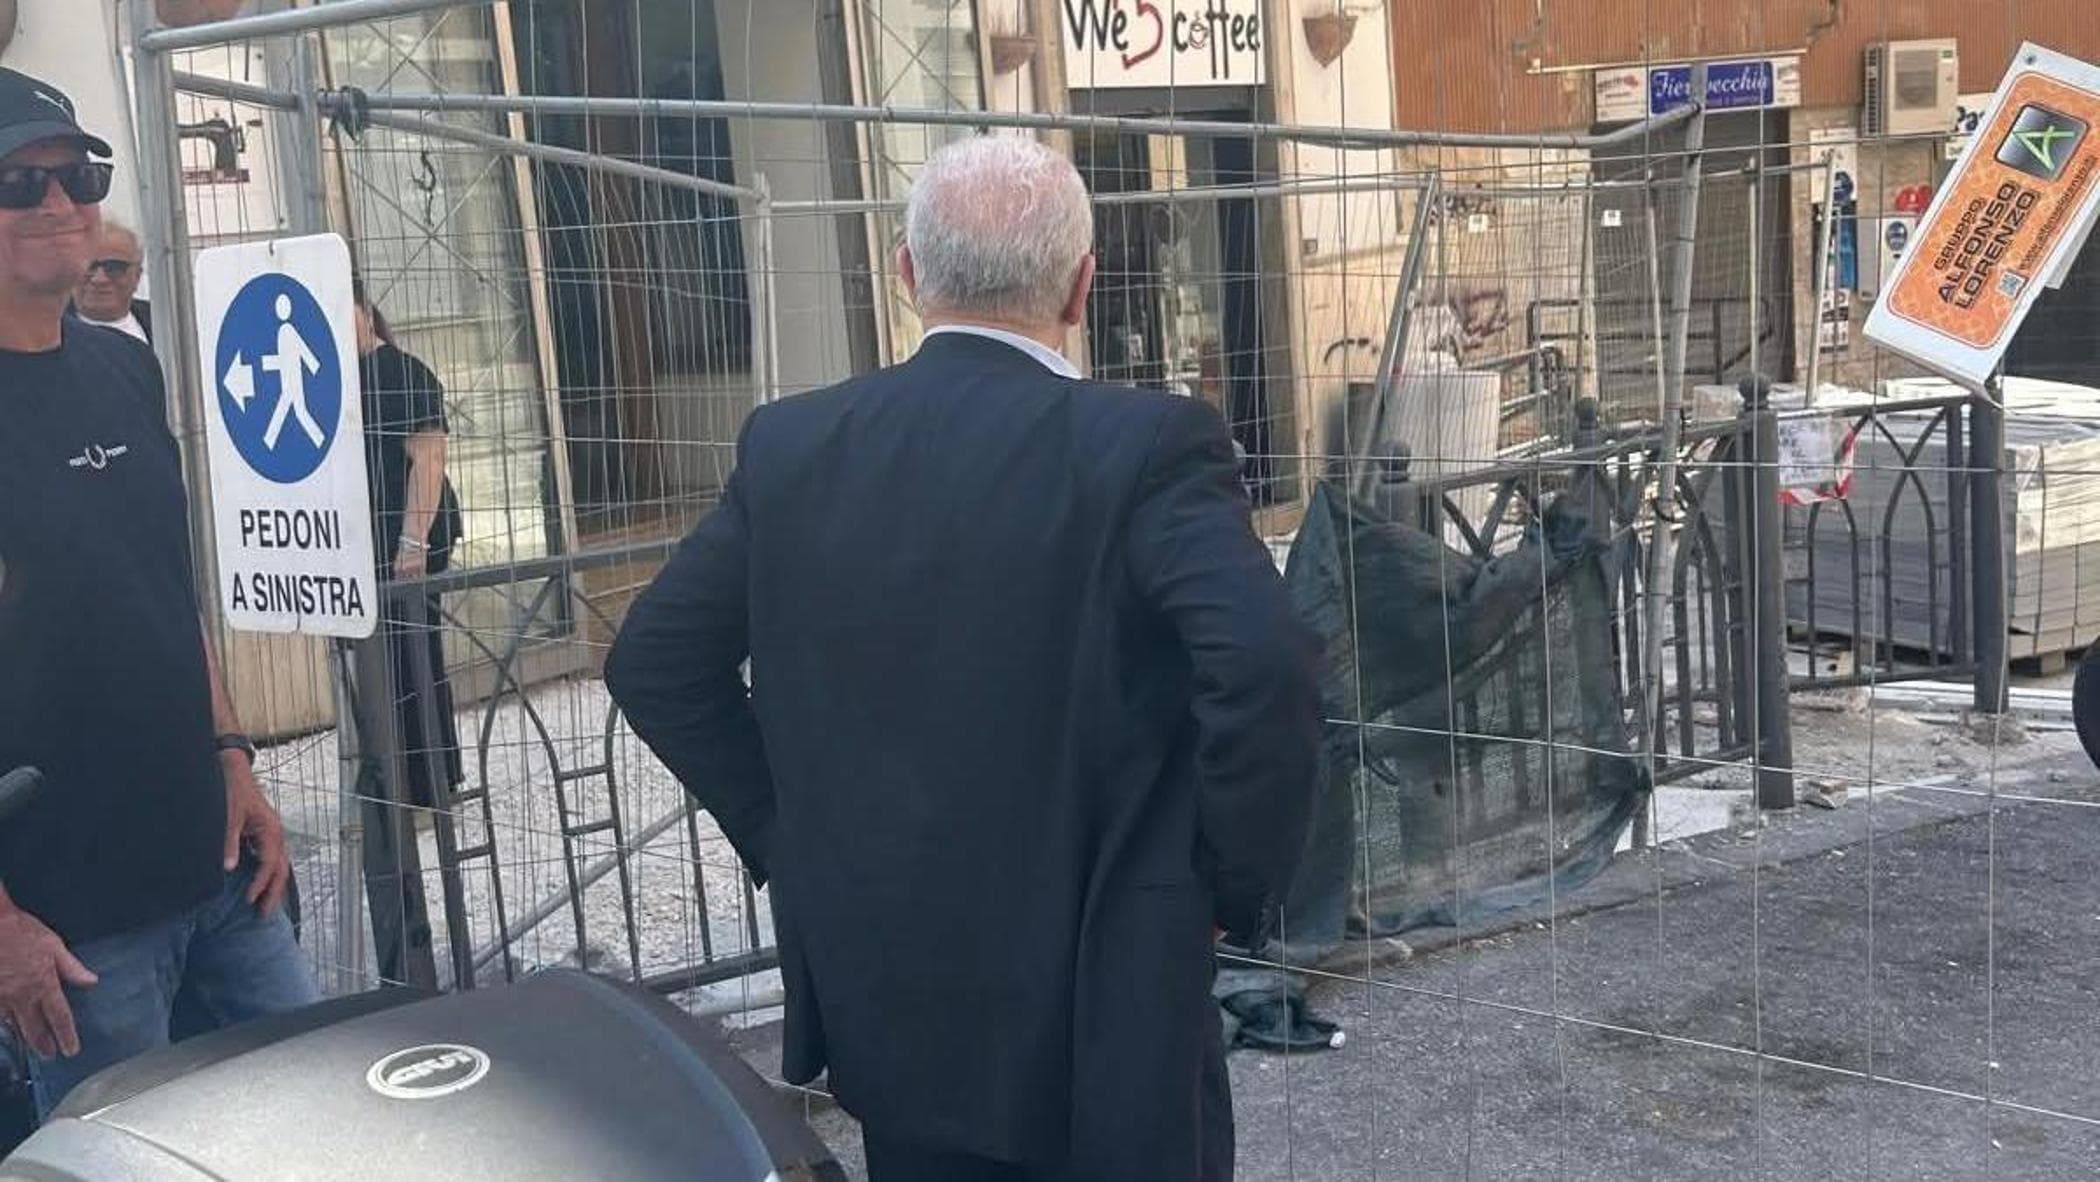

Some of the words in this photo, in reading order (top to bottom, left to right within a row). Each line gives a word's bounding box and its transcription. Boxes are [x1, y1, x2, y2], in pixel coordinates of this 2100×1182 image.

[1064, 0, 1129, 51] We
[1933, 197, 1985, 271] GRUPPO
[1938, 181, 2019, 304] ALFONSO
[1955, 190, 2041, 310] LORENZO
[240, 509, 341, 550] PEDONI
[232, 572, 248, 611] A
[252, 572, 365, 617] SINISTRA
